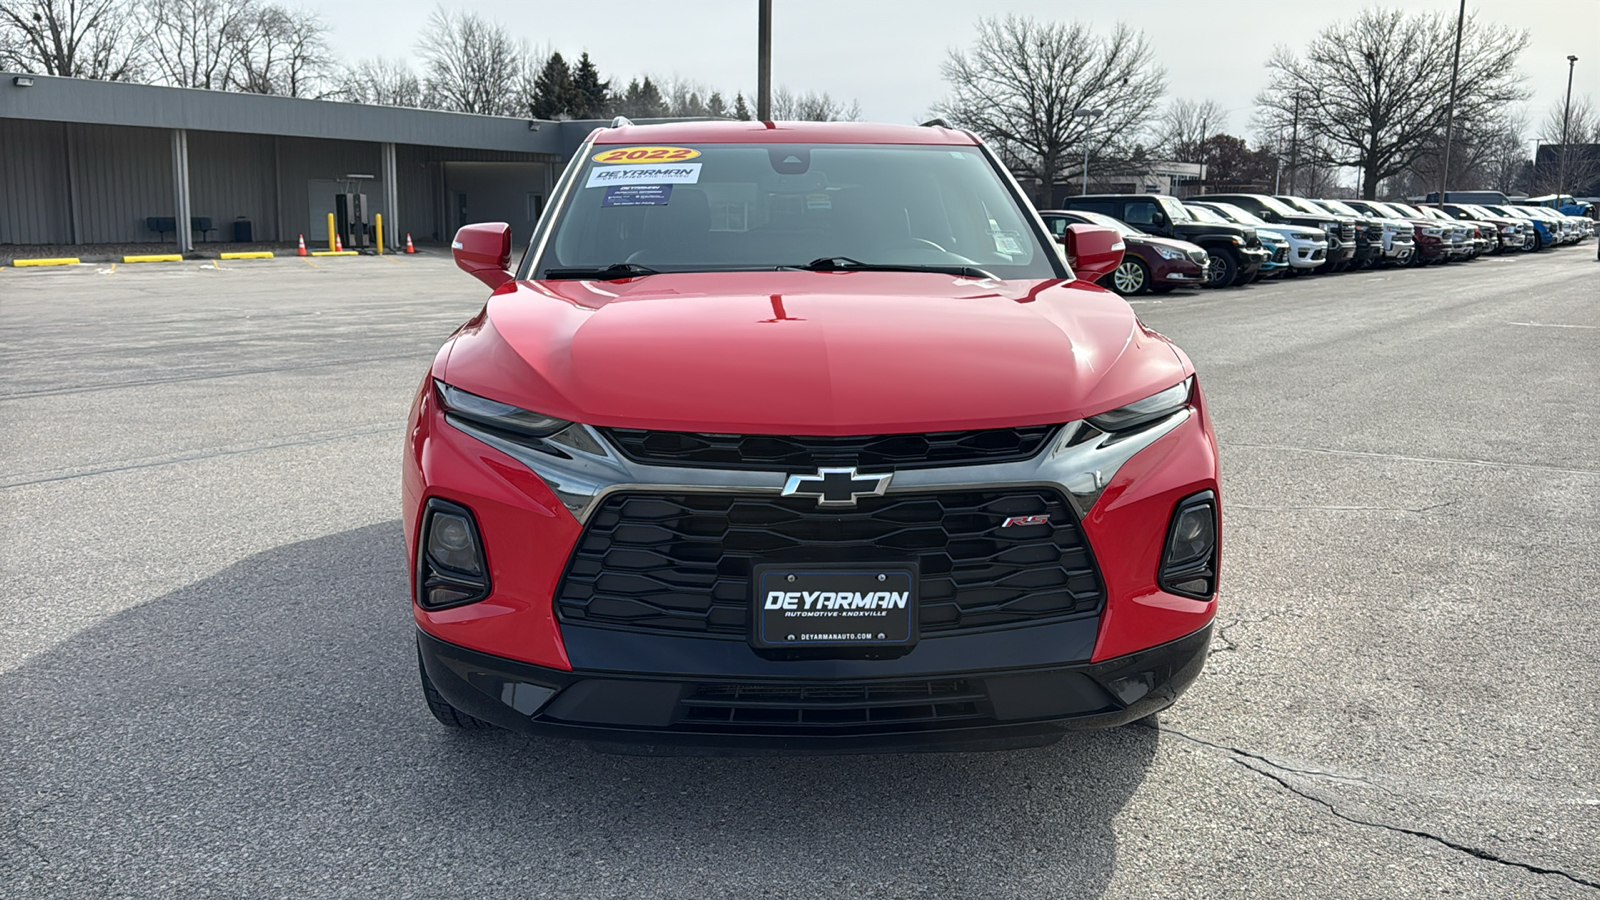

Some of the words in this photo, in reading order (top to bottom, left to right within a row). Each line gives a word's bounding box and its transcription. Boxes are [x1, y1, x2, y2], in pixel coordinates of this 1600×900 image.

[602, 149, 692, 161] 2022
[596, 169, 694, 178] DEYARMAN
[1001, 514, 1050, 527] RS
[764, 591, 909, 610] DEYARMAN
[801, 633, 872, 641] DEYARMANAUTO.COM
